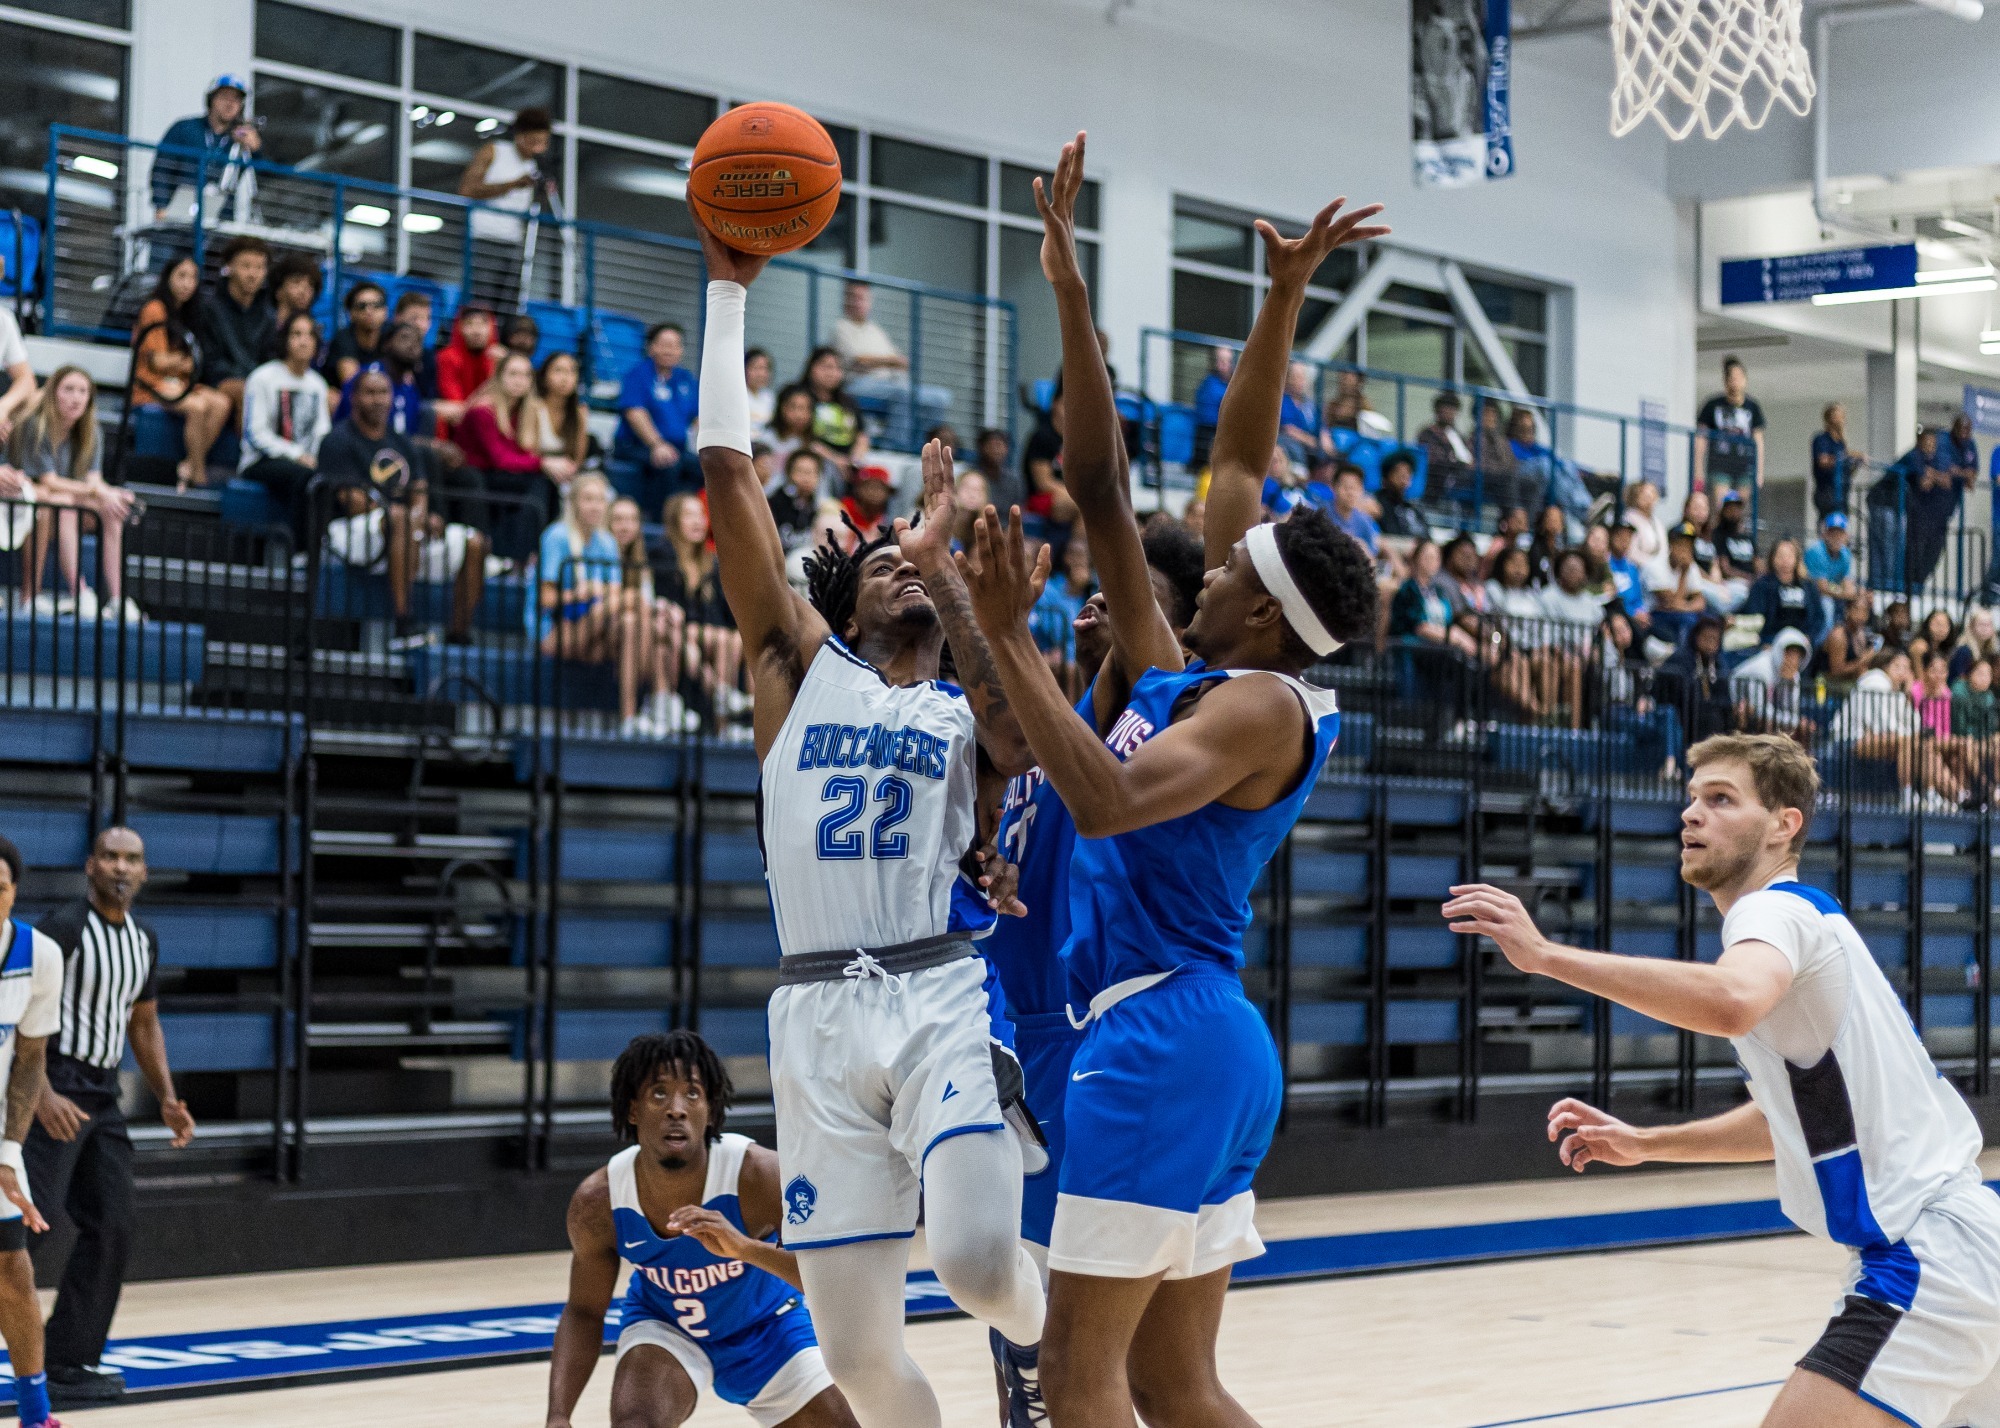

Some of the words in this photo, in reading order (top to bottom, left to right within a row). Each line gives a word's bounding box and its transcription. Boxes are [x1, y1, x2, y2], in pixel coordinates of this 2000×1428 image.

[712, 181, 799, 198] LEGACY
[719, 171, 771, 182] 1000
[710, 209, 811, 239] SPALDING
[796, 723, 950, 780] BUCCANEERS
[816, 775, 913, 860] 22
[633, 1260, 745, 1295] ALCONS
[673, 1298, 710, 1338] 2
